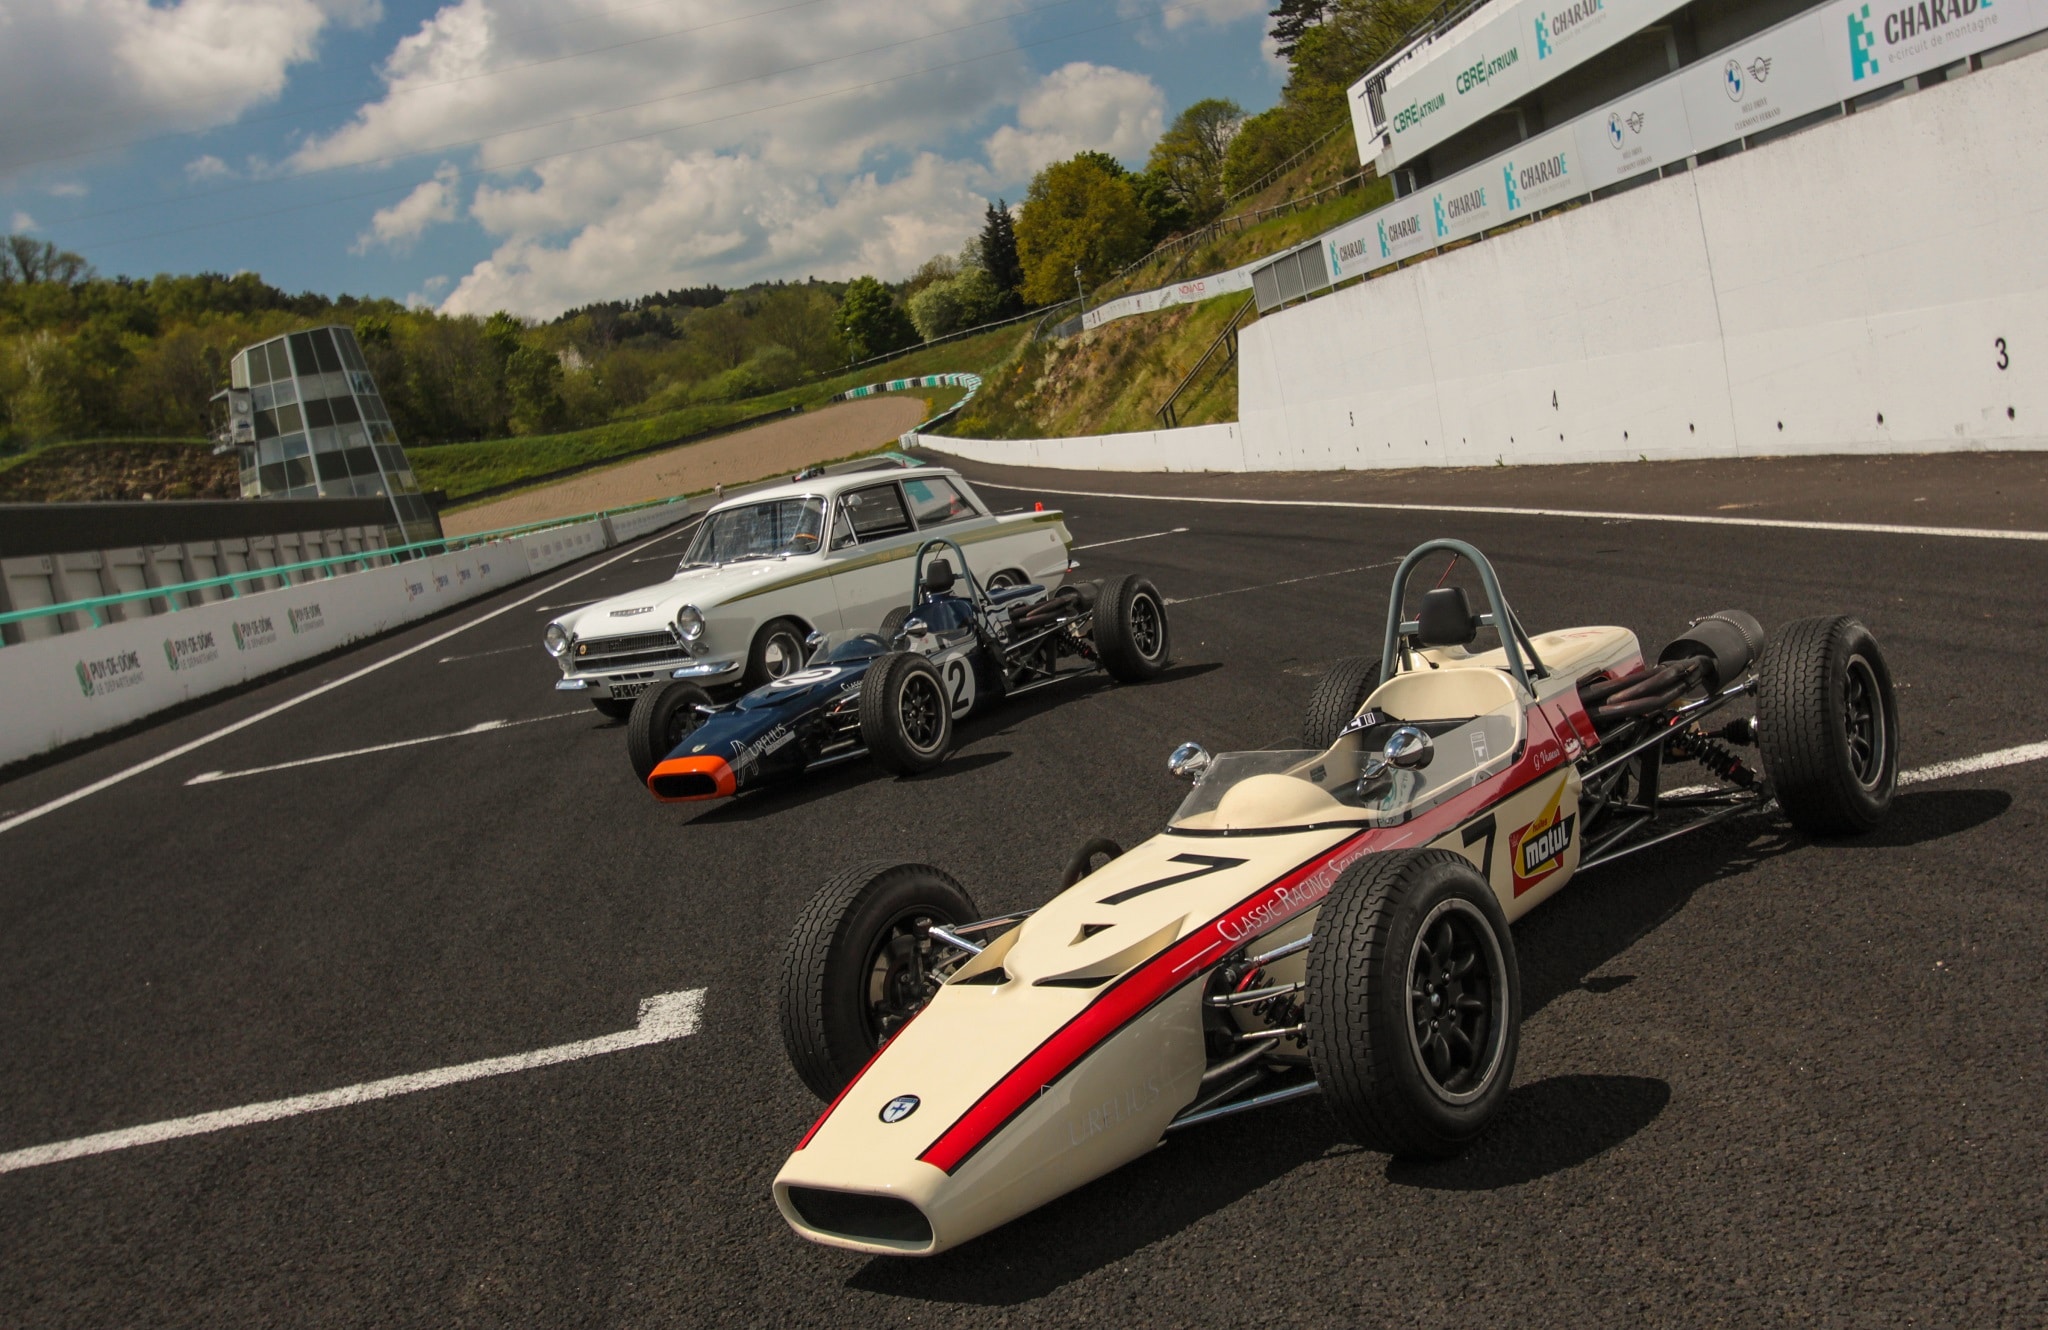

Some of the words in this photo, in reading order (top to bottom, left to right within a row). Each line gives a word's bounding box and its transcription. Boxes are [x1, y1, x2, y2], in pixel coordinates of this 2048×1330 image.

[1884, 0, 1992, 45] CHARAD
[1930, 33, 1943, 47] de
[1945, 13, 1999, 39] montagne
[1456, 59, 1486, 95] CBRE
[1487, 47, 1519, 77] ATRIUM
[1393, 102, 1417, 134] CBRE
[1419, 93, 1446, 120] ATRIUM
[1520, 152, 1568, 190] CHARADE
[1448, 187, 1487, 219] CHARADE
[1388, 214, 1422, 243] CHARADE
[1339, 238, 1367, 263] CHARADE
[1994, 337, 2009, 371] 3
[1552, 389, 1559, 411] 4
[174, 630, 216, 656] PUY-DE-DÔME
[89, 649, 141, 681] PUY-DE-DÔME
[777, 669, 833, 686] 2
[95, 684, 104, 696] LE
[840, 680, 863, 692] CLASS
[948, 660, 969, 713] 2
[730, 723, 787, 787] AURELIUS
[1461, 812, 1497, 886] 7
[1525, 820, 1569, 869] motul
[1095, 853, 1251, 906] 7
[1217, 899, 1282, 942] CLASSIC
[1274, 871, 1331, 911] RACING
